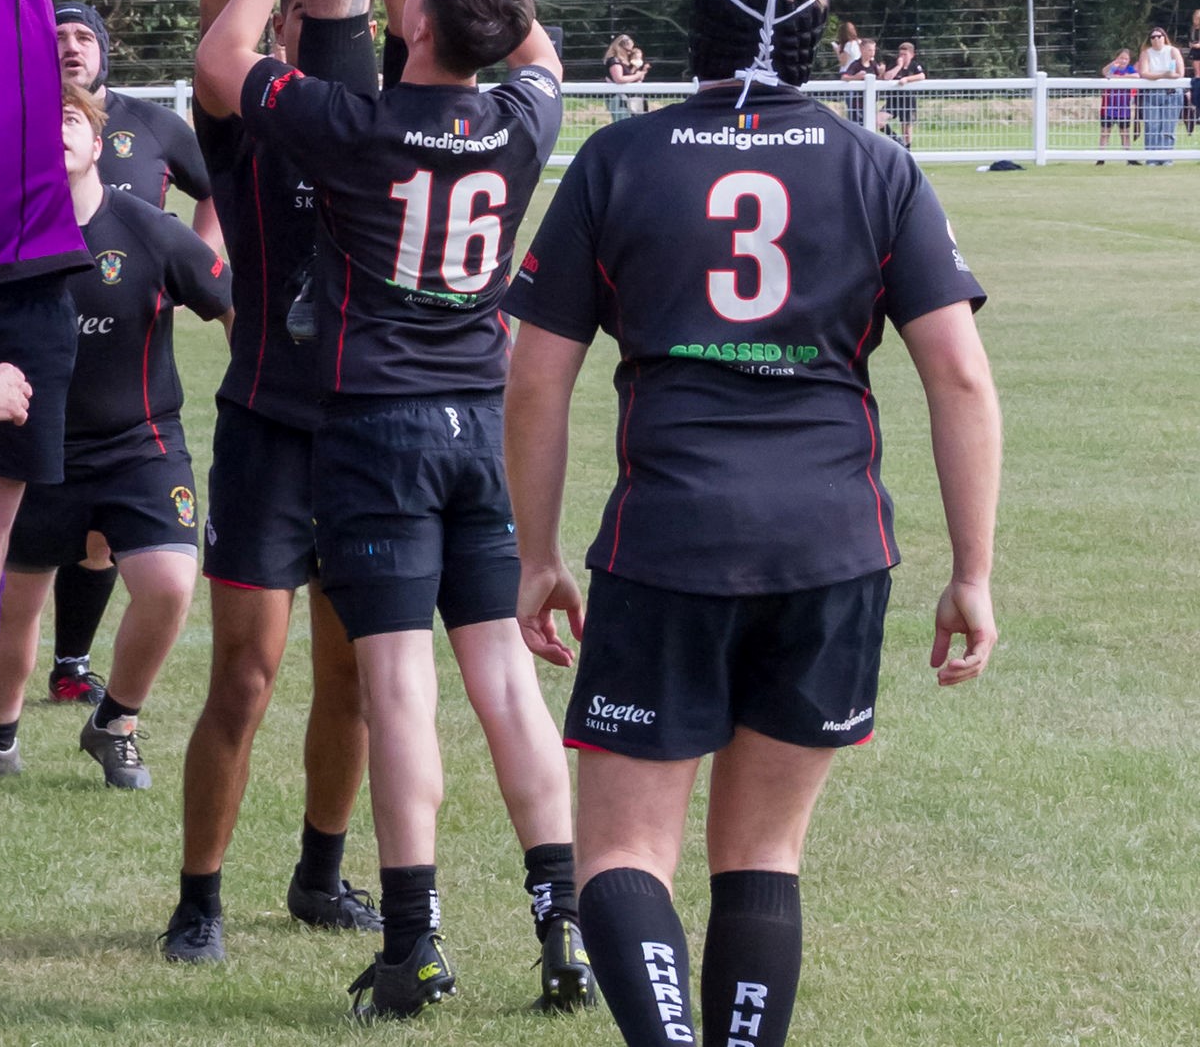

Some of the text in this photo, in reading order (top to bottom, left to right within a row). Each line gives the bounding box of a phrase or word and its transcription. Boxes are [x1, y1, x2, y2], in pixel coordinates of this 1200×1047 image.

[403, 128, 509, 154] MadiganGill
[670, 126, 825, 151] MadiganGill
[389, 168, 507, 293] 16
[705, 170, 791, 323] 3
[78, 313, 115, 335] tec
[669, 342, 818, 363] GRASSED UP
[759, 365, 795, 376] Grass
[588, 694, 657, 725] Seetec
[585, 717, 618, 733] SKILLS
[641, 941, 694, 1043] RHRFC
